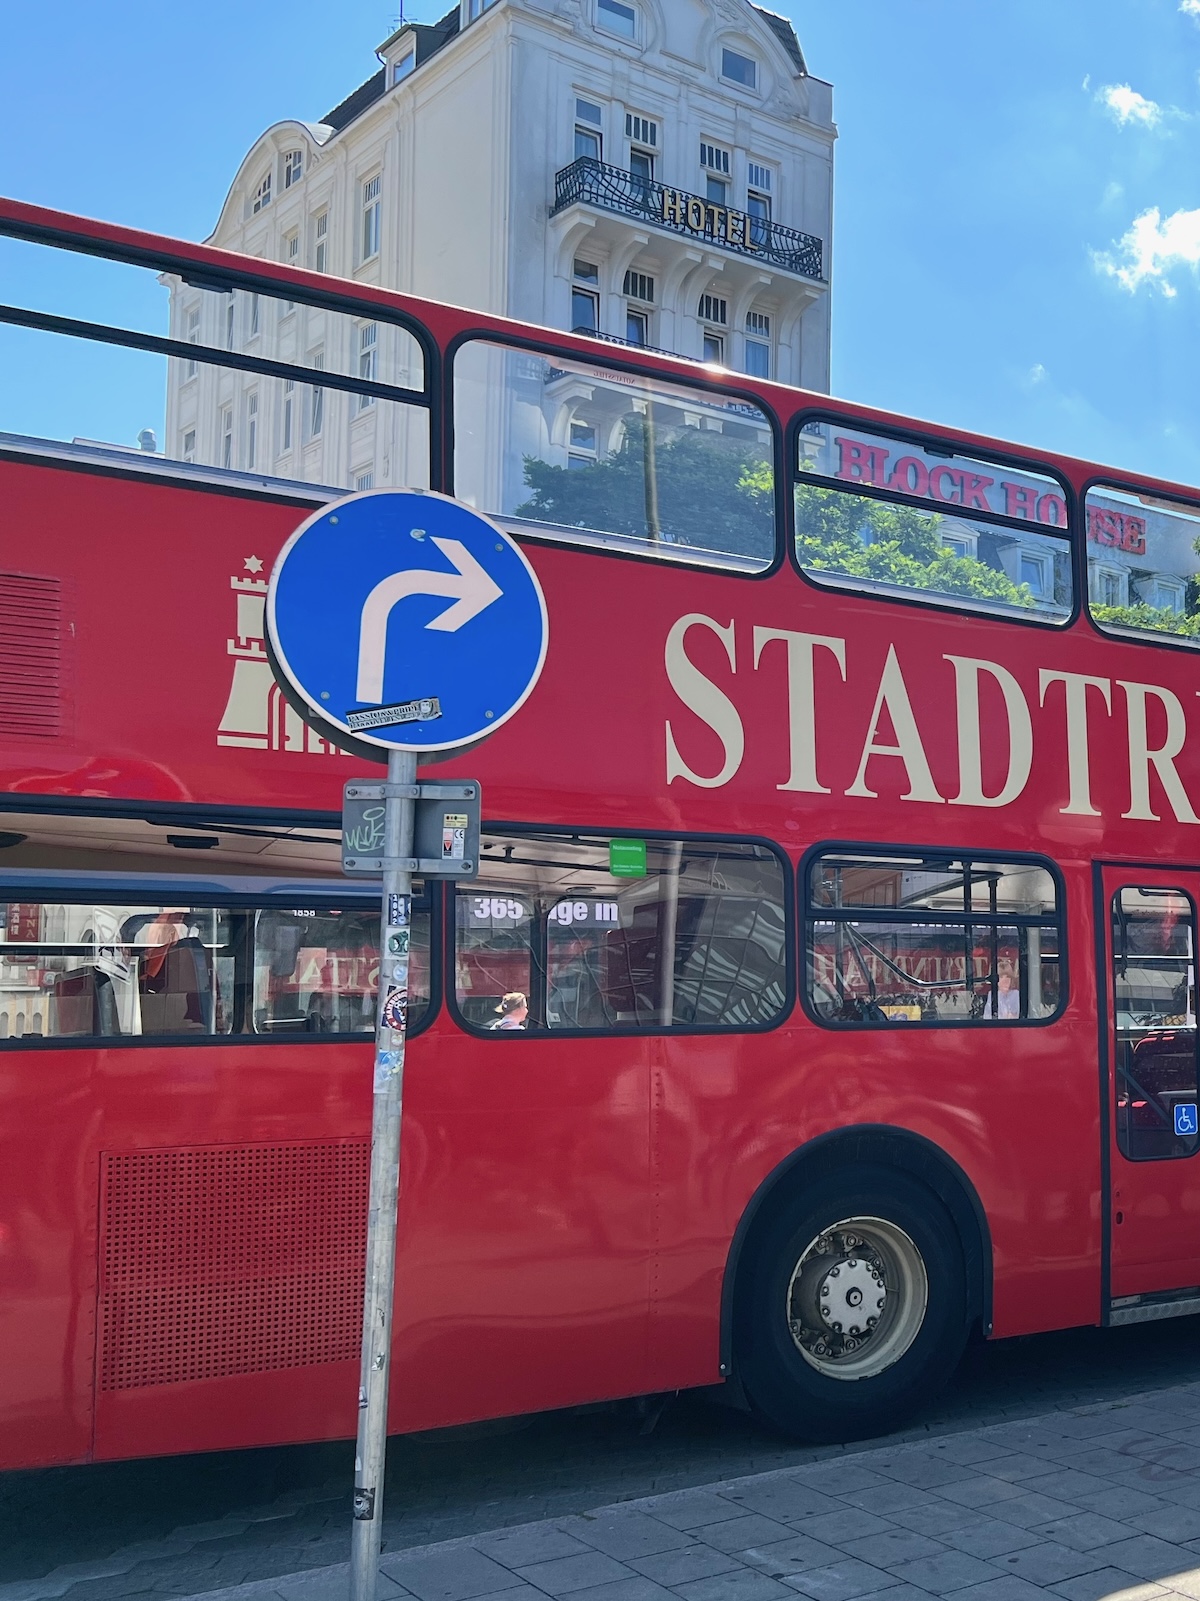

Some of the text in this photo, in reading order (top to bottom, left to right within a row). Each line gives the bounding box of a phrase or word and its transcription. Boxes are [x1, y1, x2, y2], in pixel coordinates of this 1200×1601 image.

[662, 188, 758, 250] HOTEL
[834, 436, 994, 512] BLOCK
[474, 898, 523, 919] 365
